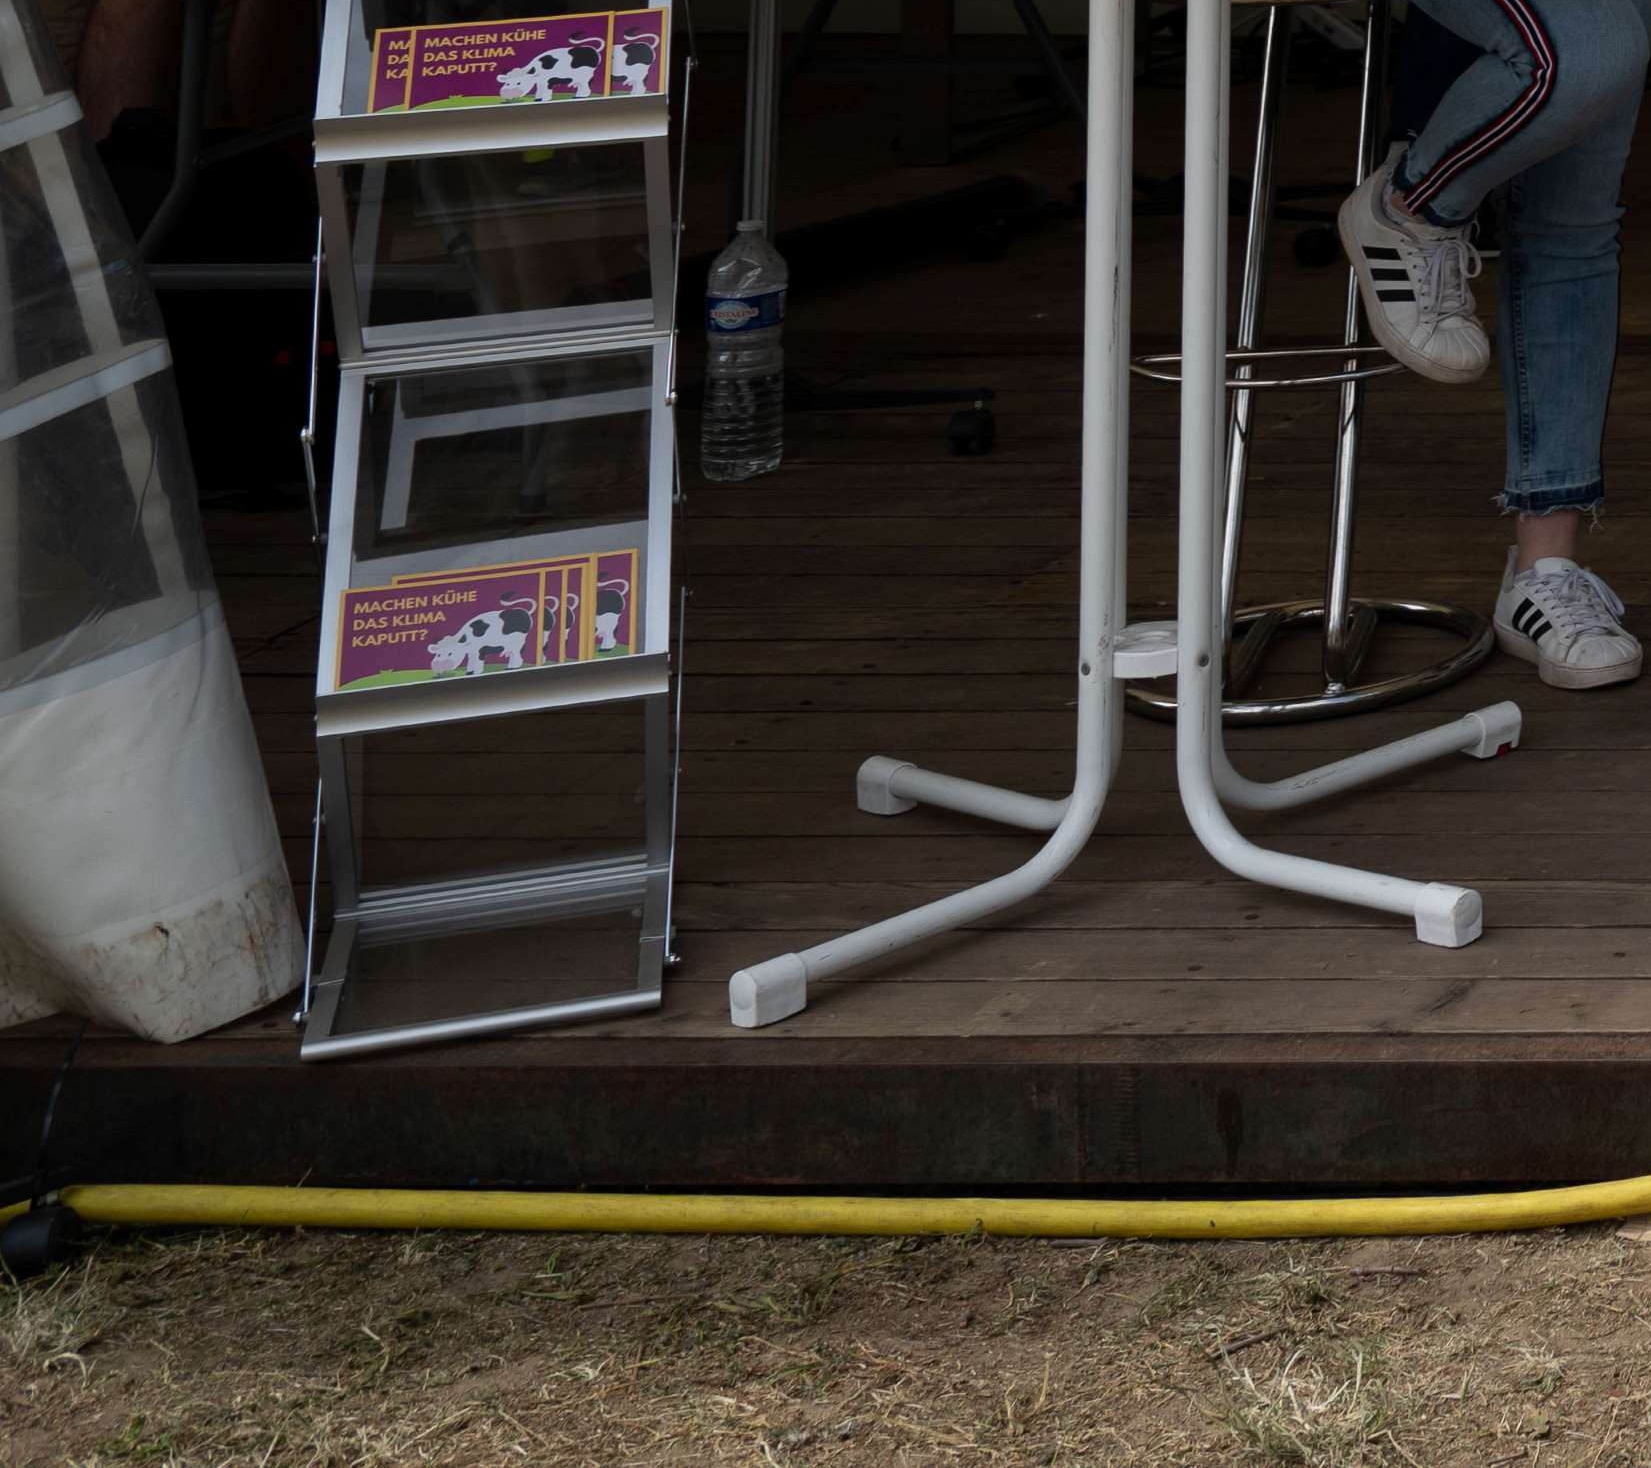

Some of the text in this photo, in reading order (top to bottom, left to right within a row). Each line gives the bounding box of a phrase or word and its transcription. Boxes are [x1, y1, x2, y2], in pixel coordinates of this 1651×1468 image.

[424, 28, 547, 49] MACHEN KÜHE
[423, 46, 516, 63] DAS KLIMA
[422, 61, 498, 77] KAPUTT?
[353, 589, 478, 615] MACHEN KÜHE
[352, 610, 446, 632] DAS KLIMA
[351, 628, 429, 648] KAPUTT?
